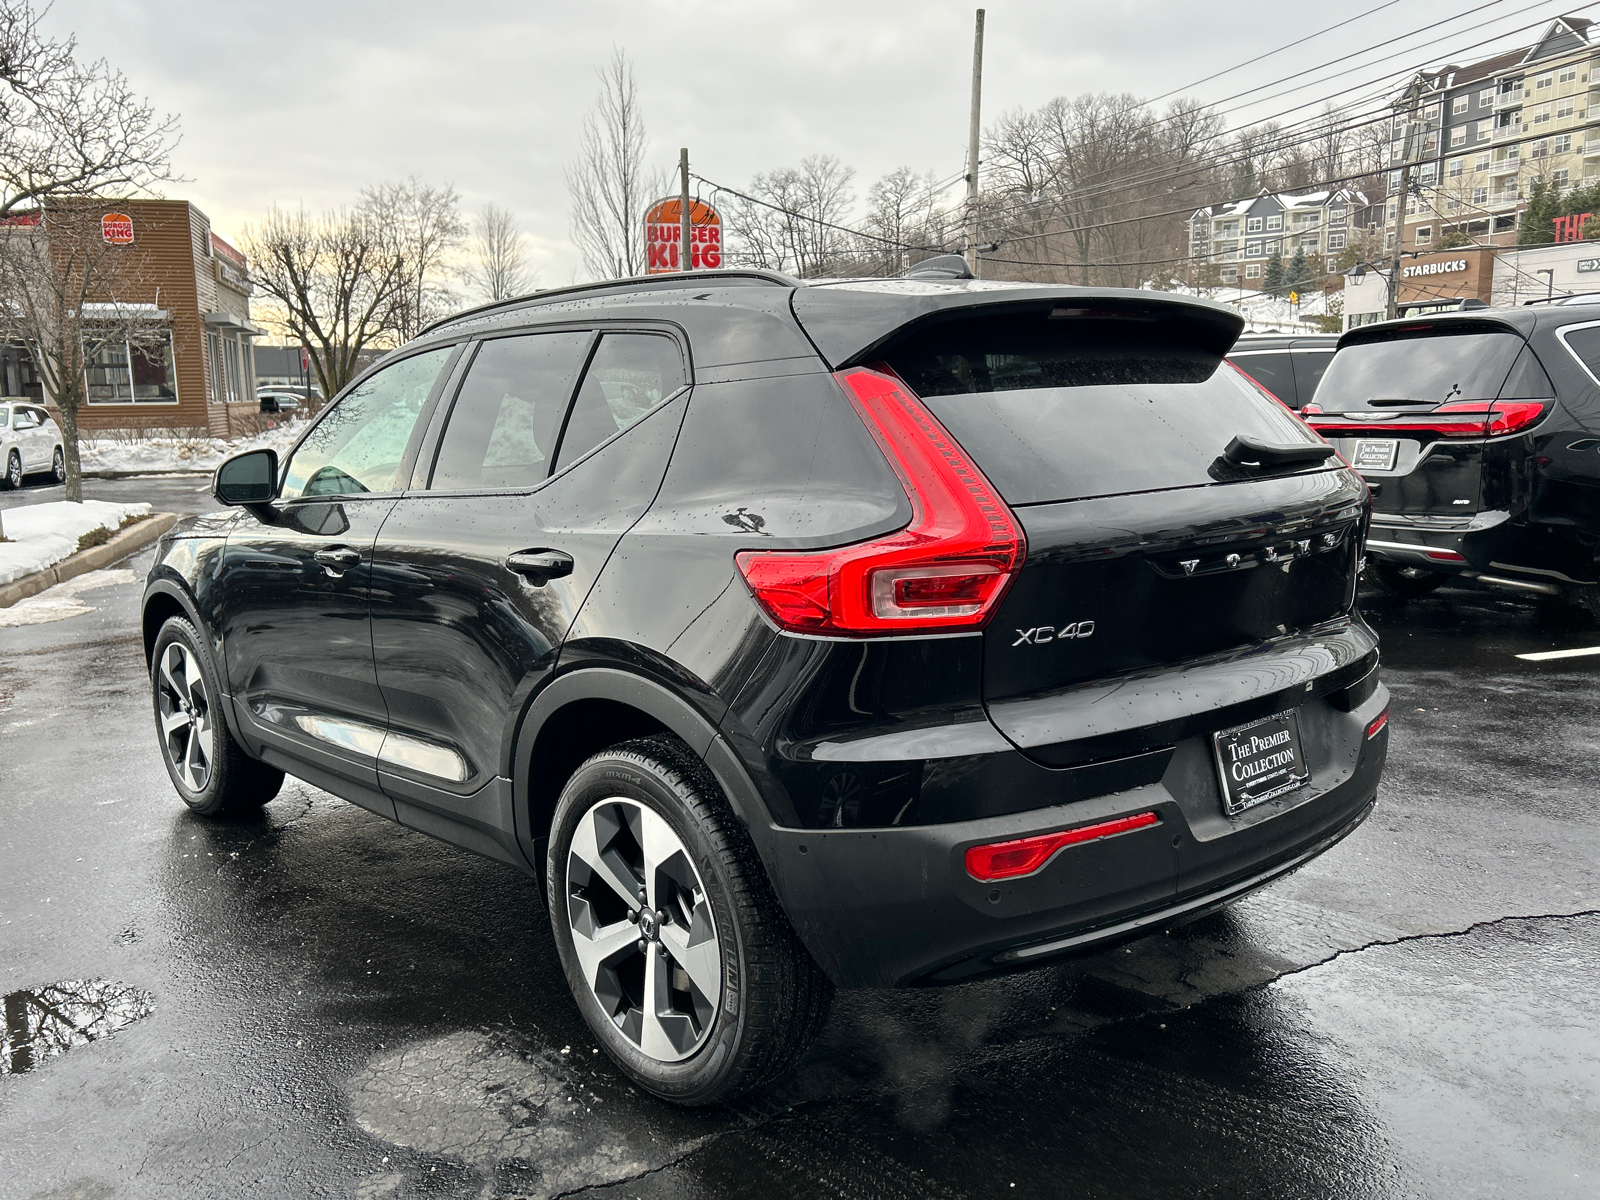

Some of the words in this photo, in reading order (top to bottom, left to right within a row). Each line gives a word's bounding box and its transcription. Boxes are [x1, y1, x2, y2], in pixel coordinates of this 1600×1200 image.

[104, 229, 132, 238] KING
[1403, 259, 1467, 278] STARBUCKS
[1232, 748, 1295, 781] COLLECTION
